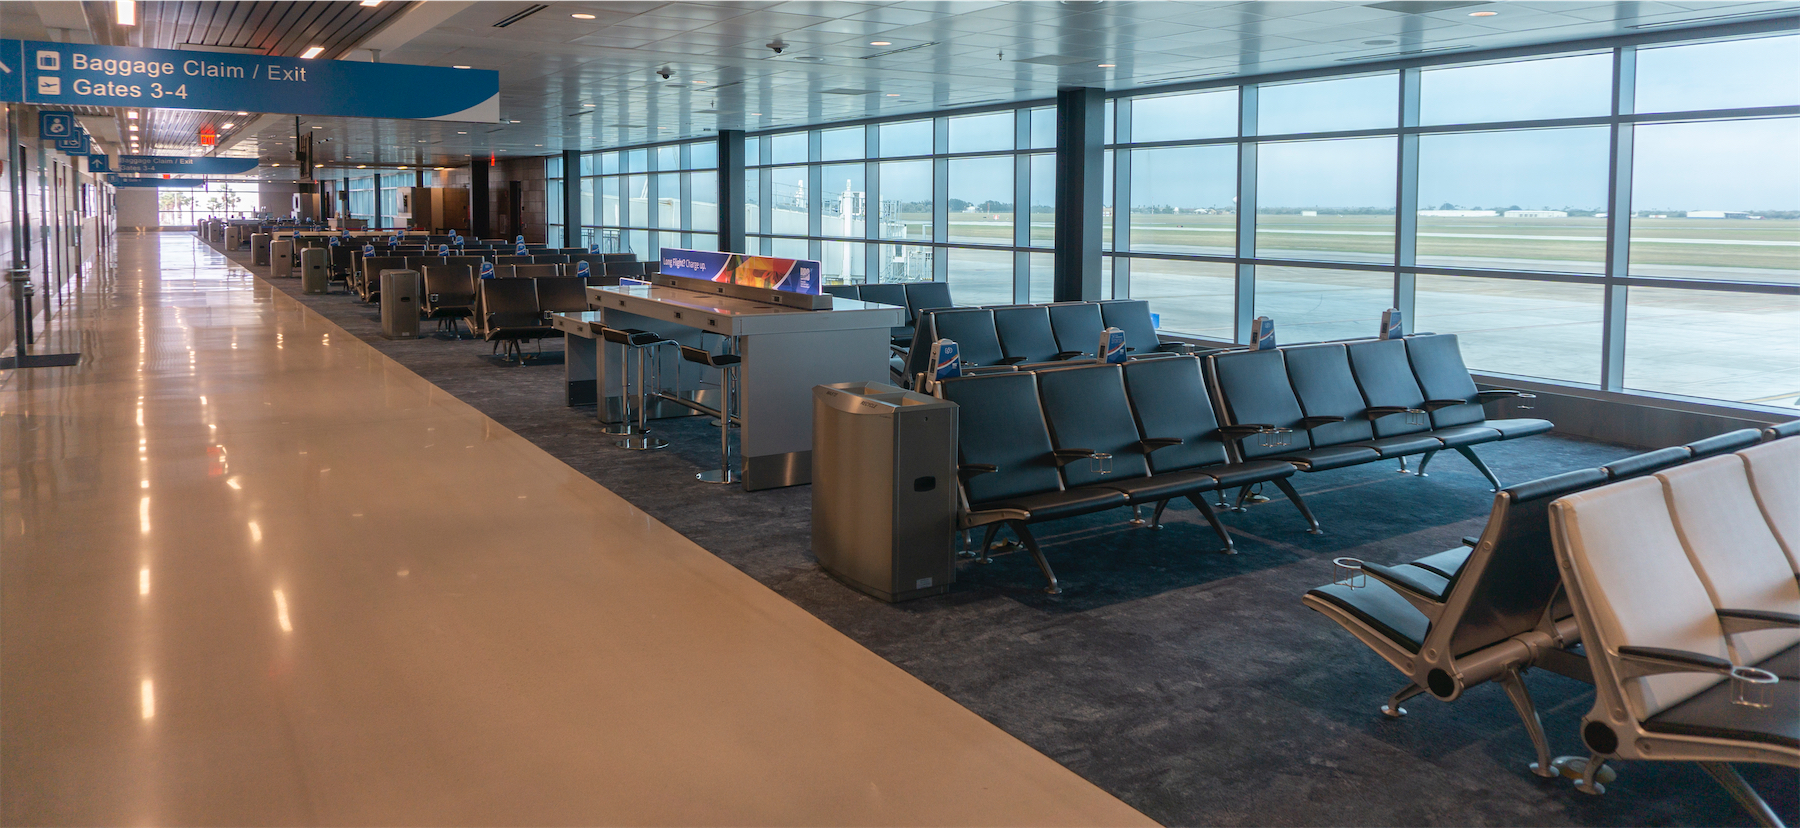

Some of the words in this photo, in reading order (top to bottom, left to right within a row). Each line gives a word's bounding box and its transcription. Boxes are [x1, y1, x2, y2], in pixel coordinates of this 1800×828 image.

[73, 53, 175, 78] Baggage
[183, 59, 245, 78] Claim
[252, 64, 260, 79] /
[268, 64, 307, 82] Exit
[72, 79, 142, 98] Gates
[150, 82, 188, 100] 3-4
[201, 135, 215, 144] EXIT
[119, 157, 151, 165] Baggage
[663, 257, 673, 268] Long
[672, 258, 686, 269] Flight?
[686, 259, 700, 271] Charge
[699, 262, 707, 271] up.
[860, 400, 878, 409] RECYCLE
